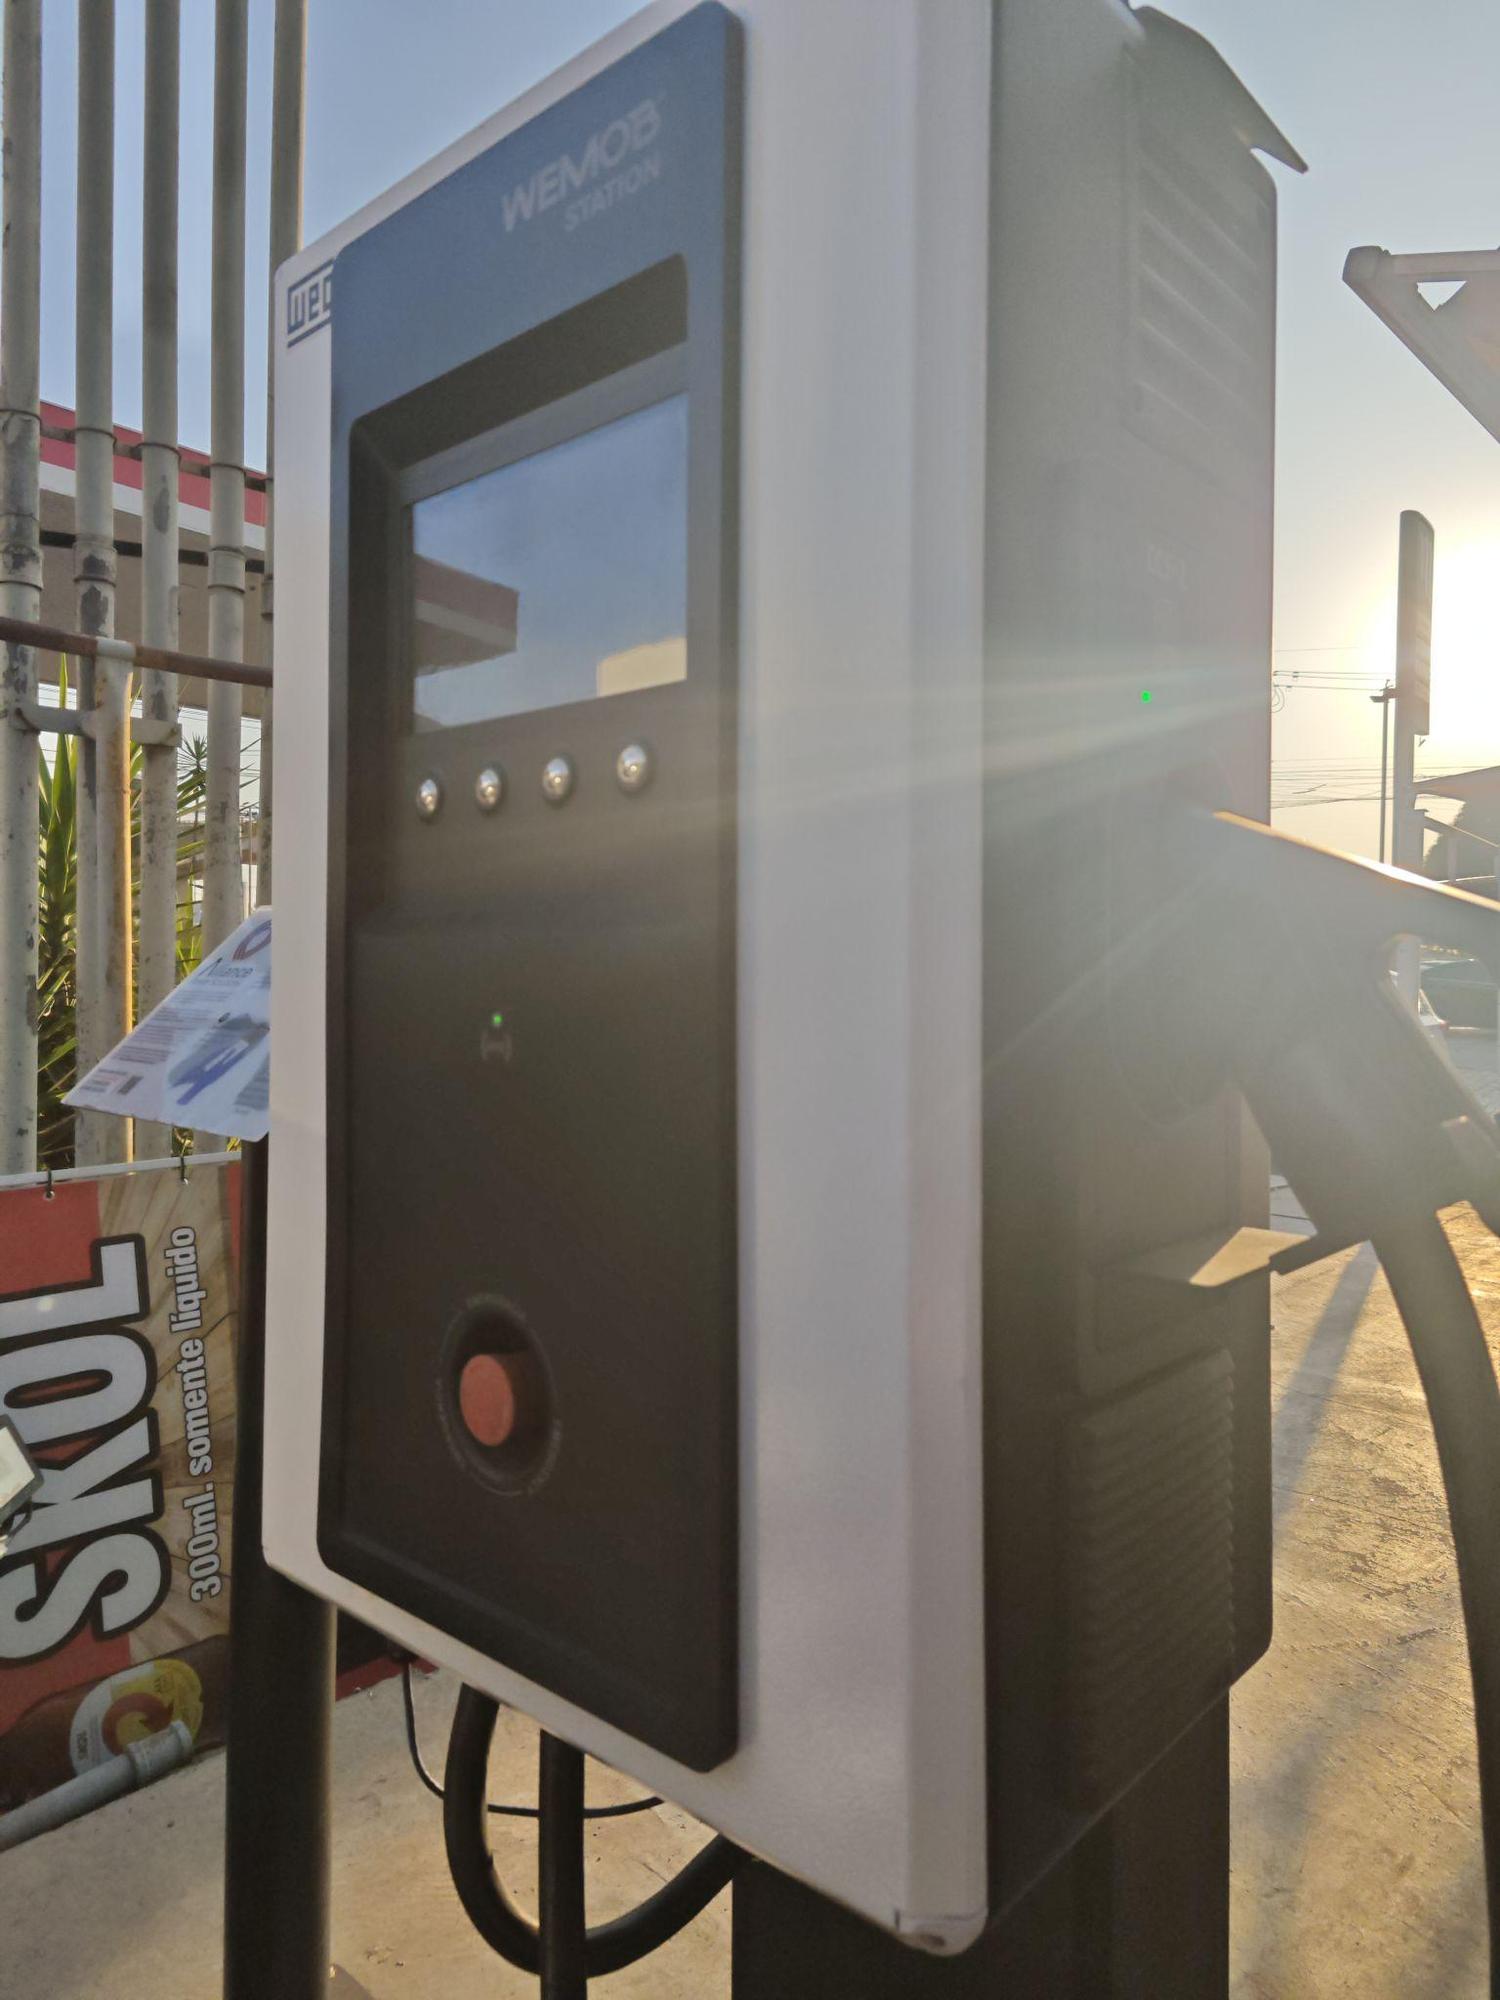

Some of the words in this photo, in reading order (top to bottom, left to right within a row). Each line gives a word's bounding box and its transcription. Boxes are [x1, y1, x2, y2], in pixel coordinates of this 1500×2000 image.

[500, 98, 662, 233] WEMOB
[564, 150, 661, 233] STATION
[166, 1226, 207, 1332] líquido
[0, 1238, 166, 1661] SKOL
[178, 1339, 213, 1475] somente
[184, 1482, 221, 1601] 300ml.
